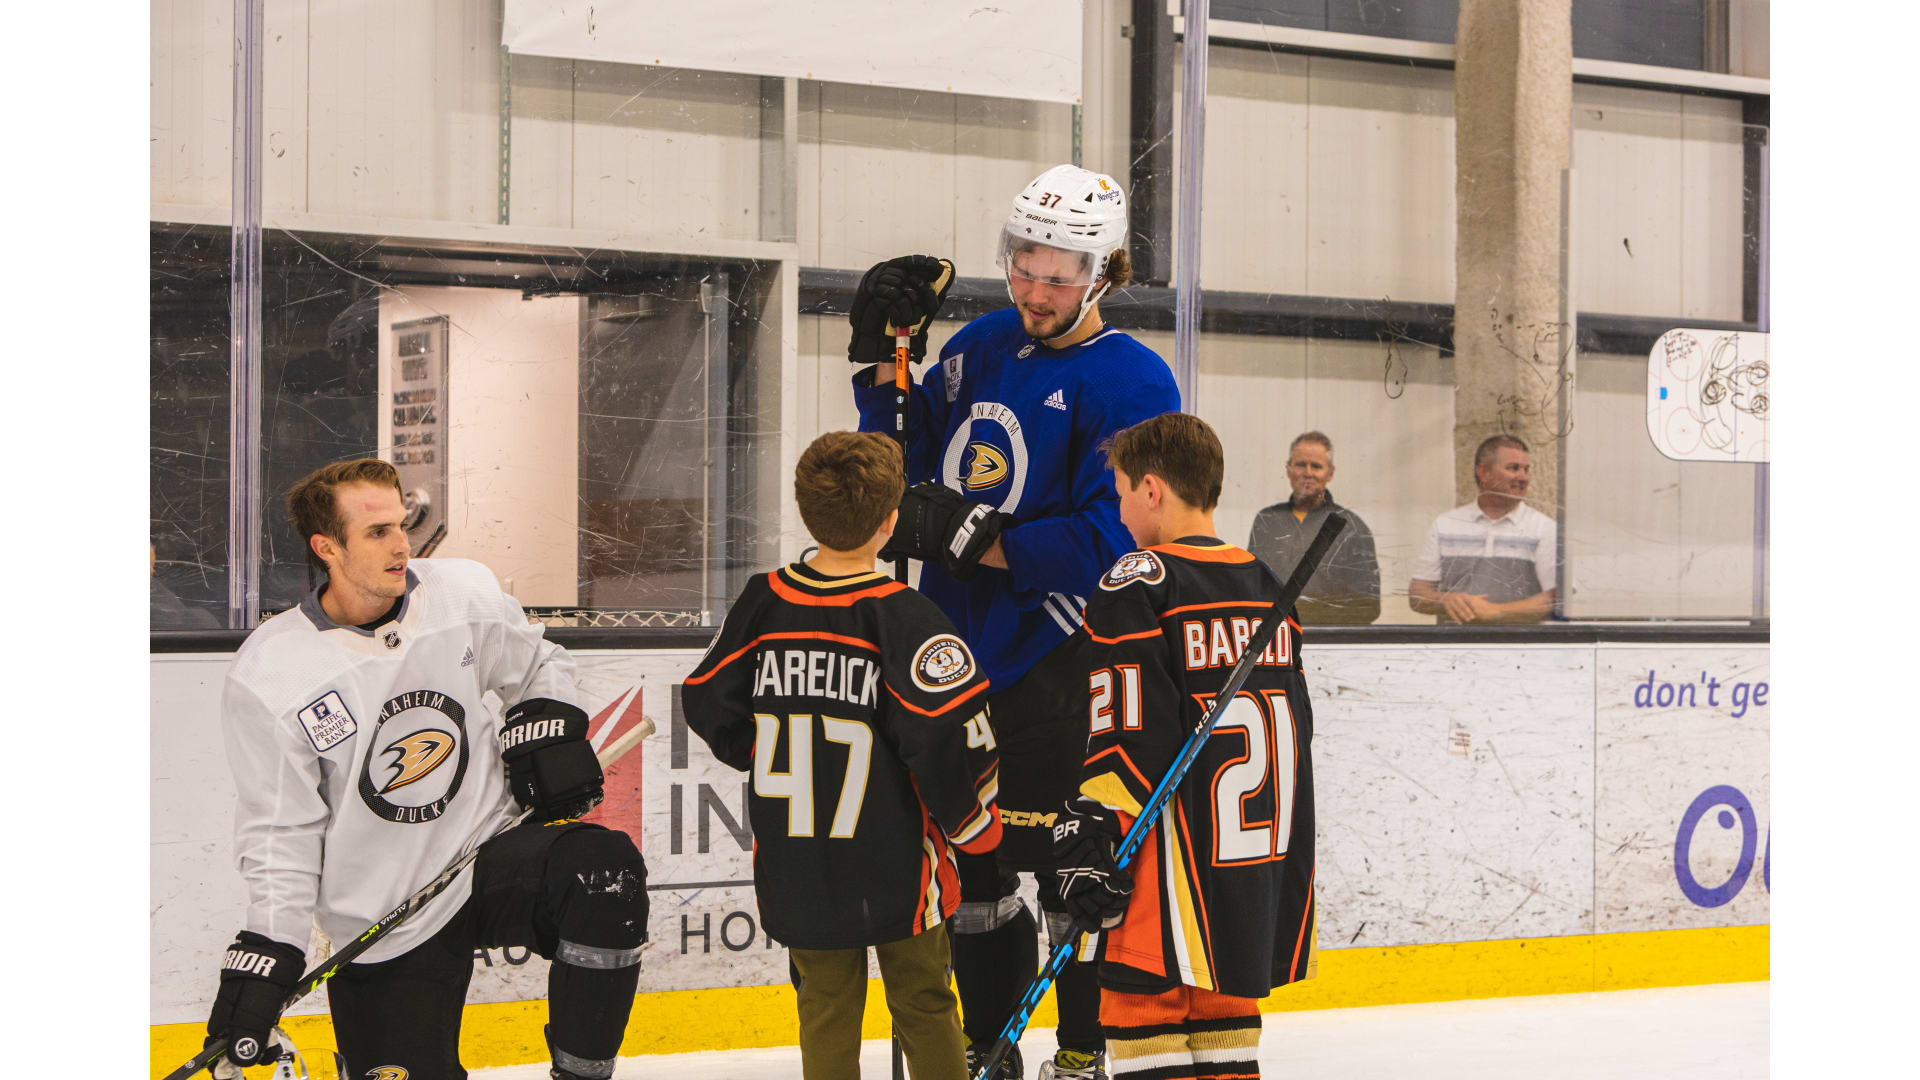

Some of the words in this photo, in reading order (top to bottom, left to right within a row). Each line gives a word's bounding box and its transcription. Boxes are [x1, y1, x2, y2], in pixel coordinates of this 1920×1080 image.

[1039, 192, 1062, 209] 37
[1043, 399, 1067, 411] adidas
[752, 650, 881, 710] ARELICK
[938, 664, 969, 683] DUCKS
[1634, 669, 1721, 708] don't
[376, 691, 446, 731] NAHEIM
[1089, 664, 1143, 736] 21
[311, 710, 343, 734] PACIFIC
[314, 716, 350, 742] PREMIER
[324, 727, 350, 745] BANK
[500, 718, 565, 754] RRIOR
[963, 702, 997, 752] 4
[753, 712, 874, 839] 47
[1191, 688, 1298, 868] 21
[999, 809, 1059, 828] CCM
[1674, 784, 1770, 909] O
[380, 903, 407, 926] ALPHA
[681, 910, 773, 955] HO
[222, 950, 277, 977] RIOR
[1008, 943, 1074, 1045] CCM
